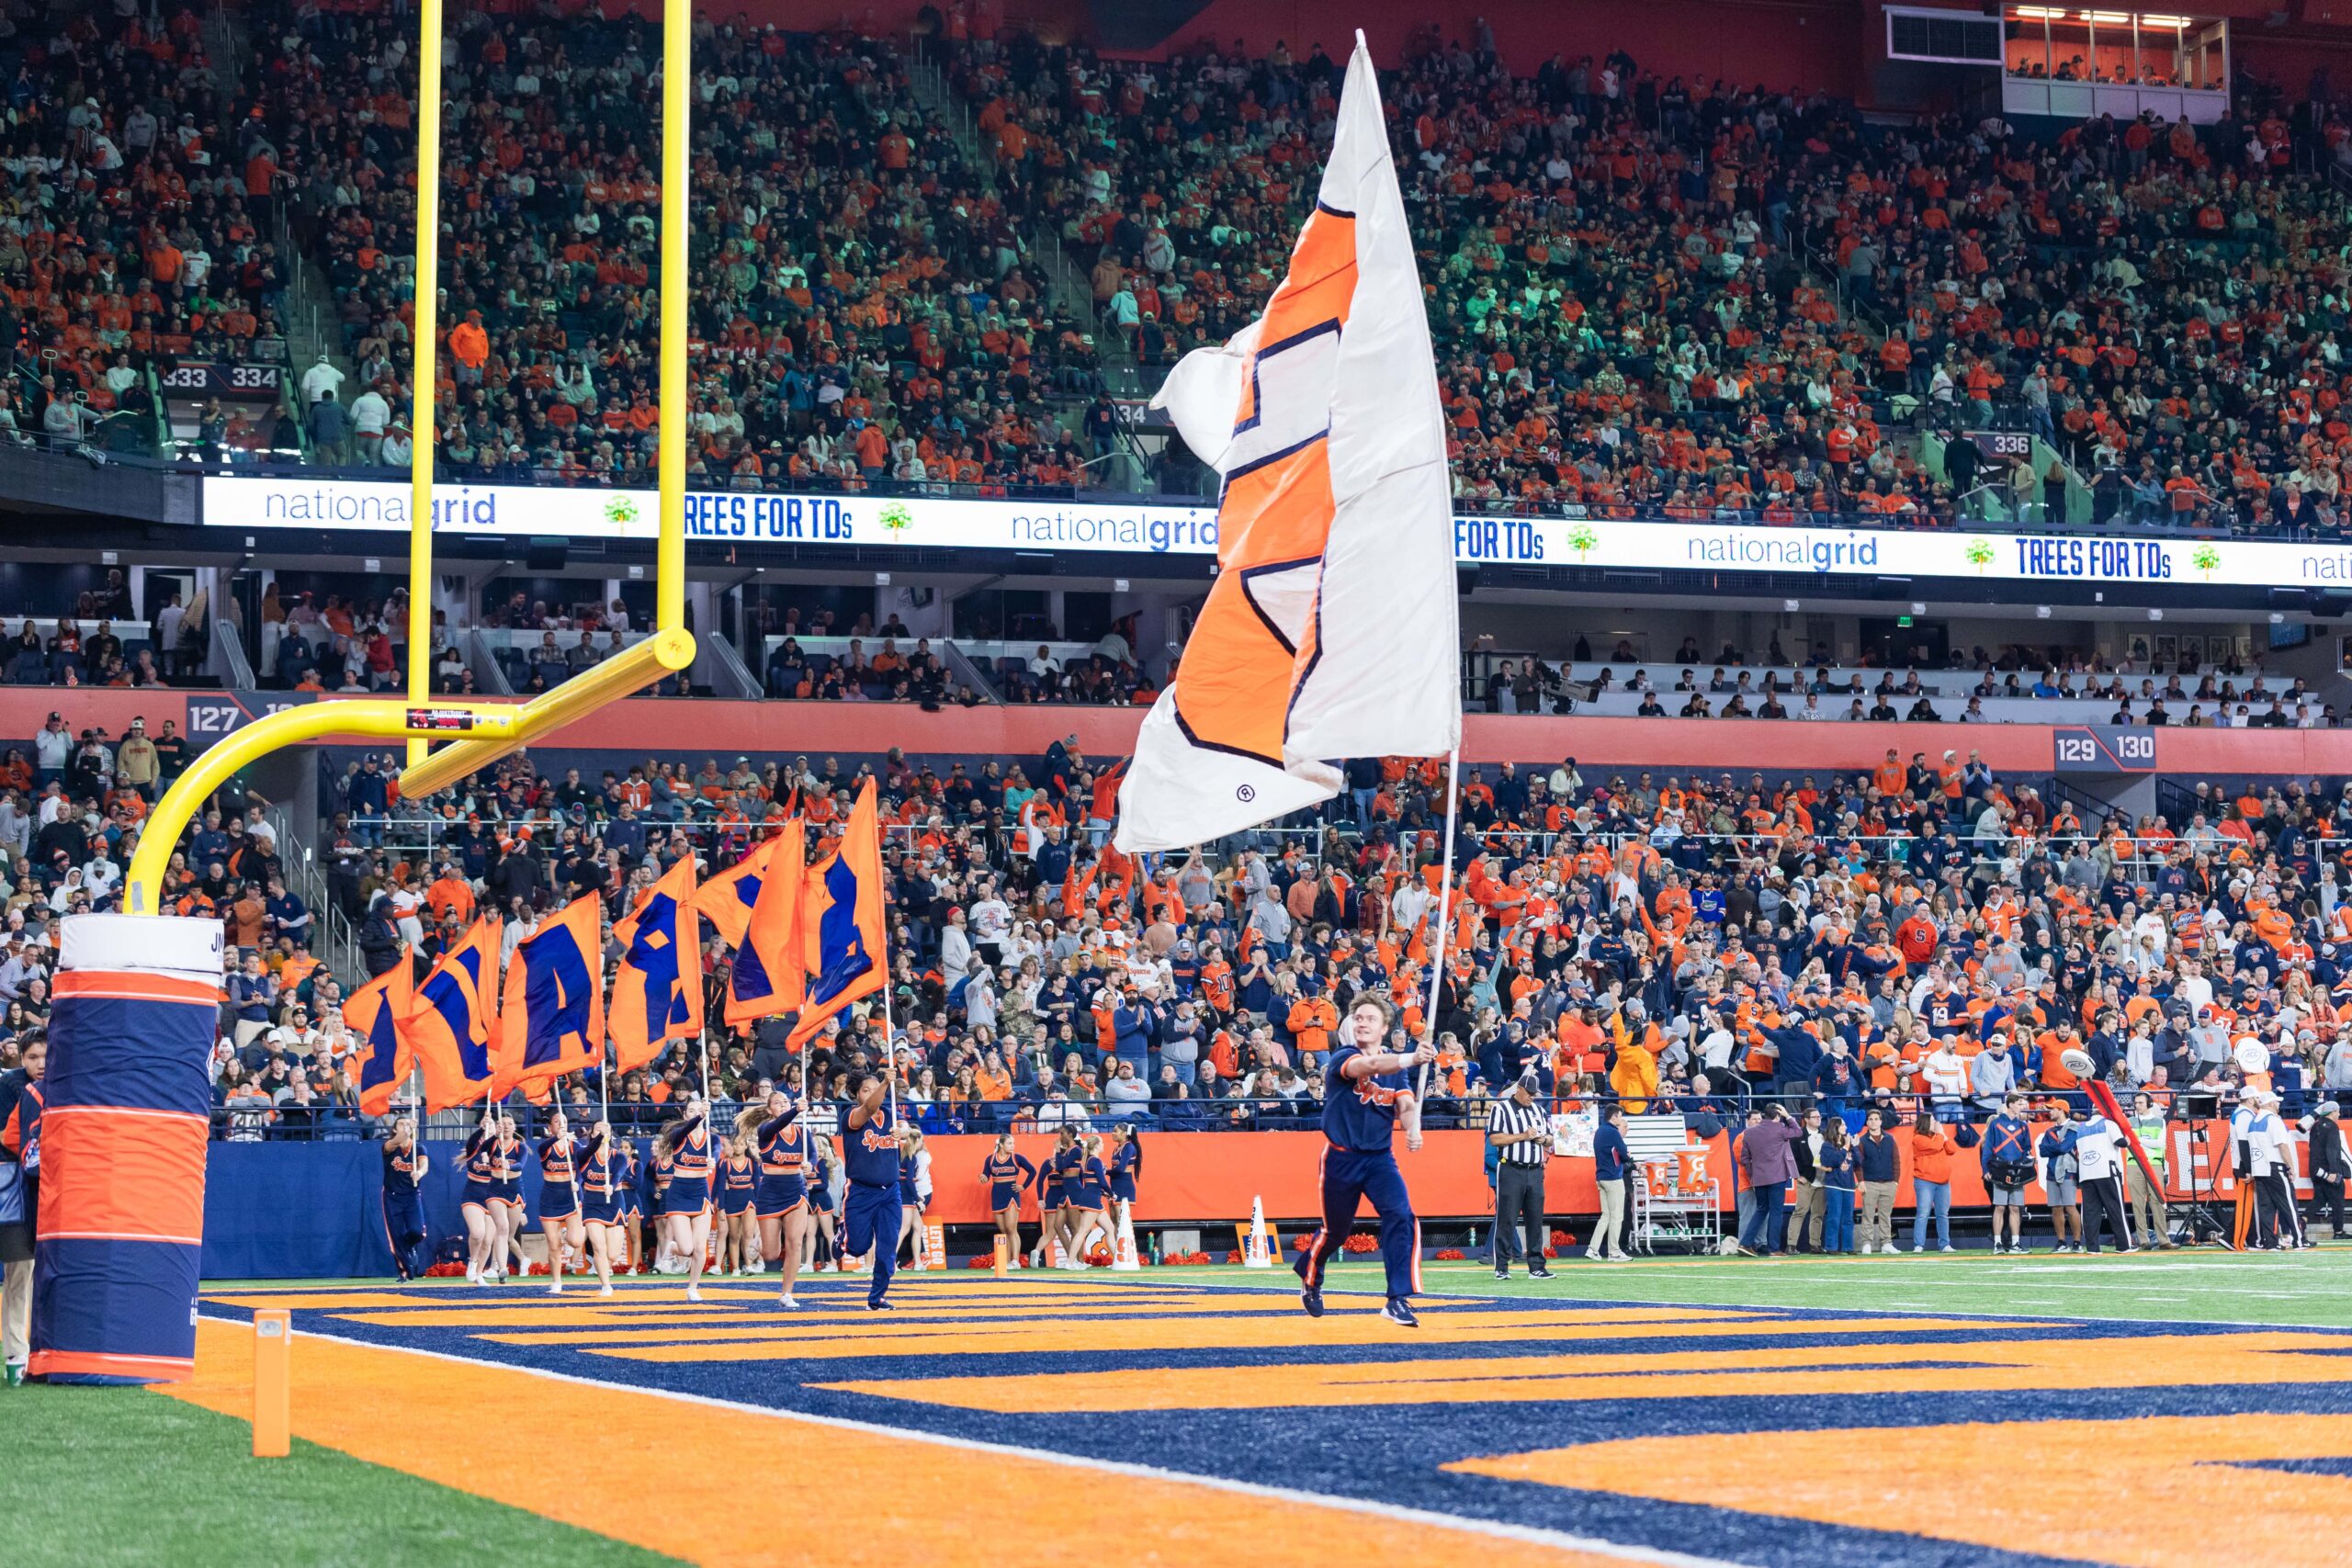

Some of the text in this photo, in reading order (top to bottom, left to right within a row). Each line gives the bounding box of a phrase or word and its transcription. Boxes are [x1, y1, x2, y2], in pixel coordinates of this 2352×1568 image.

[233, 368, 277, 388] 334
[1995, 436, 2030, 454] 336
[685, 495, 853, 540] REES FOR TDs
[1012, 510, 1219, 553] nationalgrid
[1453, 520, 1544, 560] FOR TDs
[1687, 532, 1878, 573] nationalgrid
[2015, 537, 2172, 580] TREES FOR TDs
[190, 706, 240, 732] 127
[2057, 739, 2096, 761] 129
[2116, 736, 2154, 759] 130
[1655, 1168, 1665, 1179] G
[1691, 1157, 1705, 1172] G
